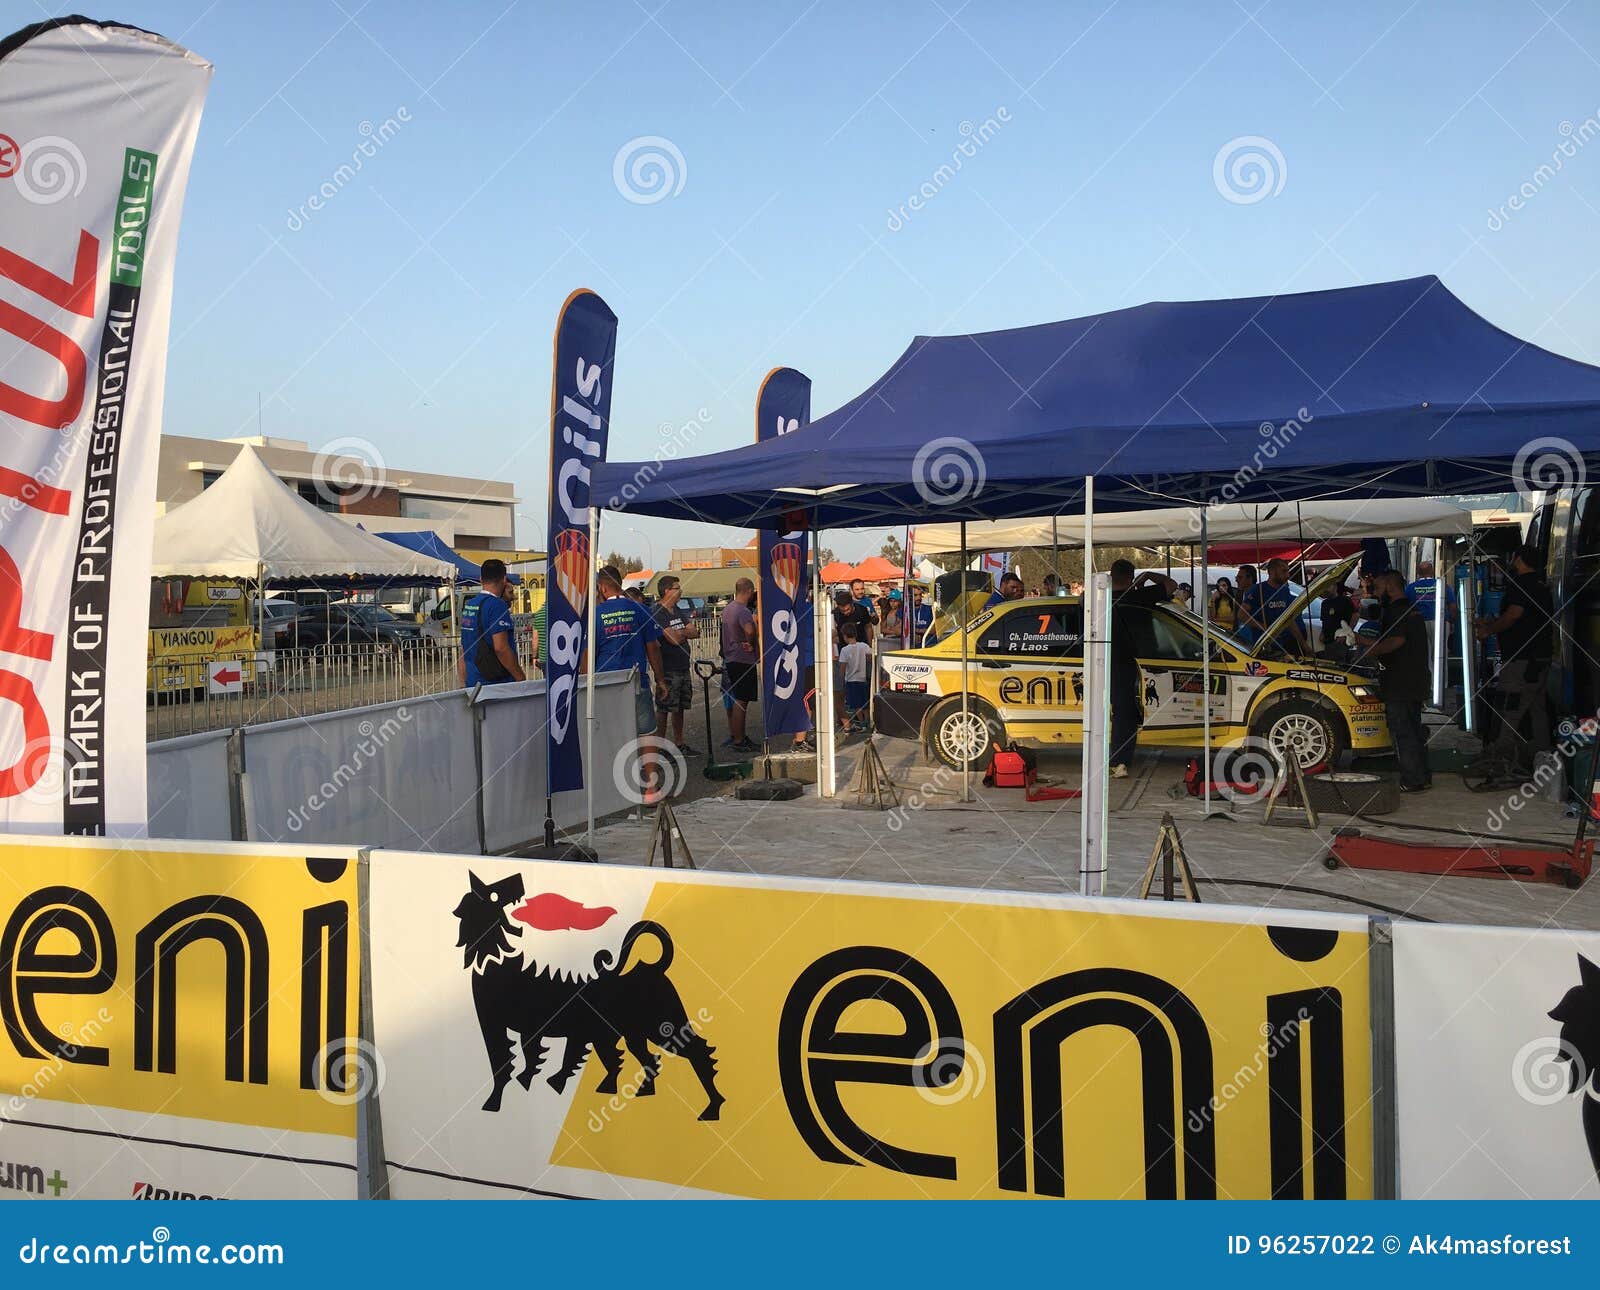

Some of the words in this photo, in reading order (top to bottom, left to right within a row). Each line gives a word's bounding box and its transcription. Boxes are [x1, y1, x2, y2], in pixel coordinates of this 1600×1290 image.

[115, 154, 151, 277] TOOLS
[76, 298, 136, 582] PROFESSIONAL
[558, 356, 601, 525] Oils
[73, 603, 103, 651] OF
[160, 630, 214, 647] YIANGOU
[1009, 632, 1021, 641] Ch.
[1023, 632, 1079, 641] Demosthenous
[1038, 614, 1051, 634] 7
[772, 609, 799, 700] Q8
[1008, 642, 1018, 651] P.
[1021, 642, 1049, 651] Laos
[894, 665, 929, 673] PETROLINA
[1213, 675, 1220, 695] 7
[1289, 670, 1345, 683] ZEMCO
[999, 671, 1066, 705] eni
[1351, 714, 1385, 723] platinum
[68, 670, 103, 805] MARK
[0, 857, 350, 1093] eni
[778, 925, 1347, 1200] eni
